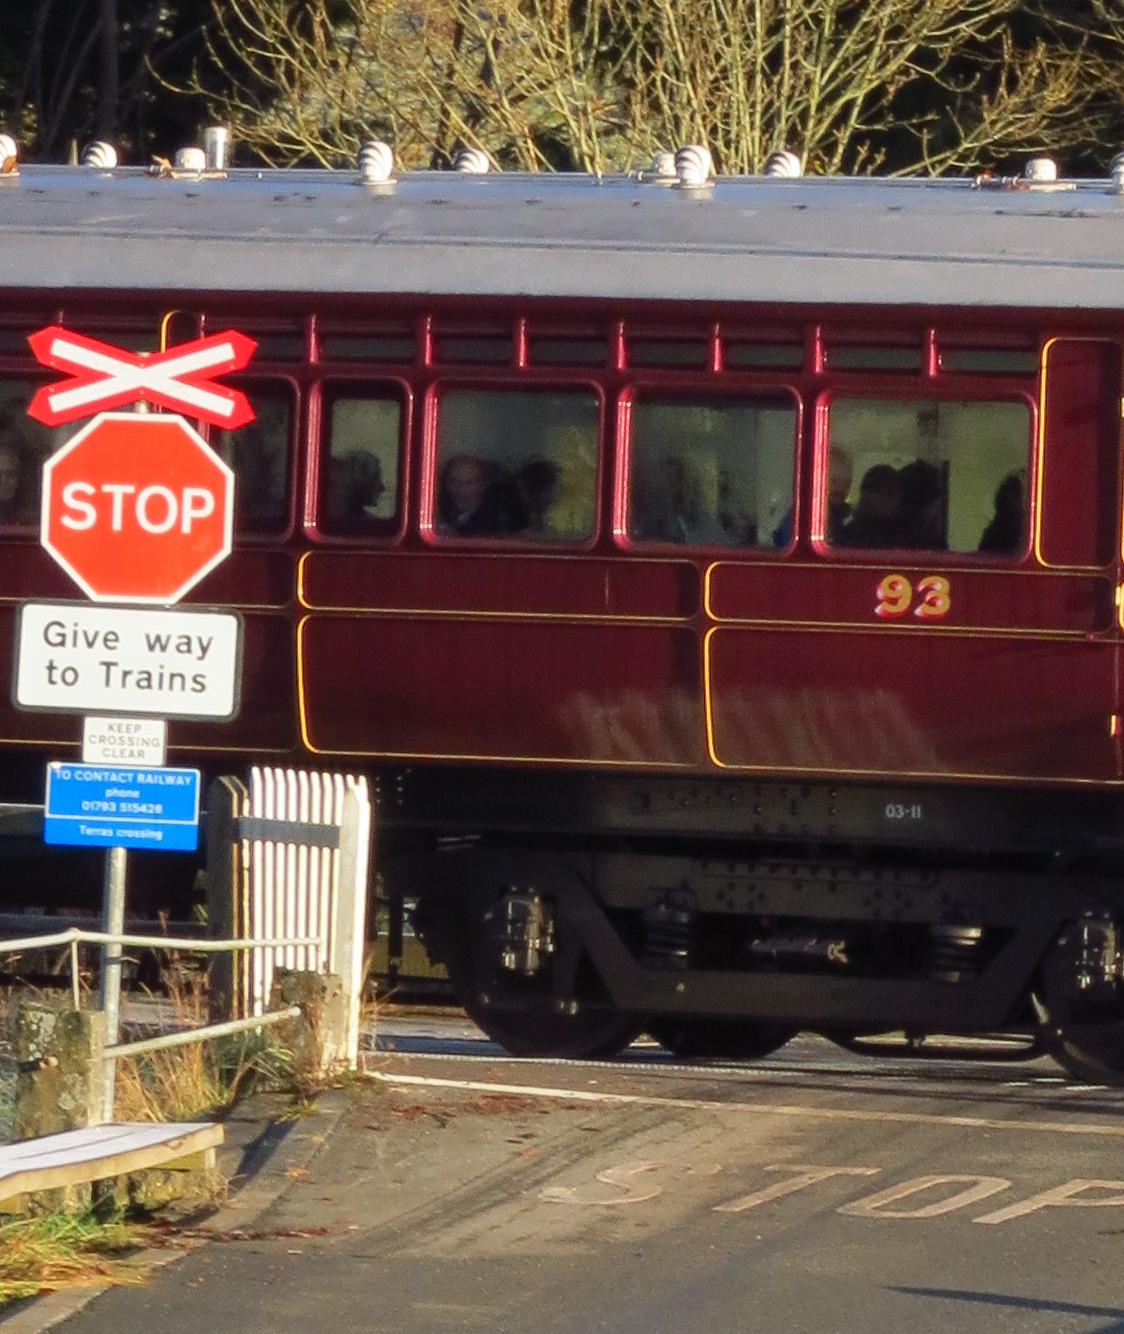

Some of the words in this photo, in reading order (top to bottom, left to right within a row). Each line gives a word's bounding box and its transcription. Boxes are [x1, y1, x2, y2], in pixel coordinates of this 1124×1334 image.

[60, 481, 215, 535] STOP
[874, 574, 951, 617] 93
[43, 620, 120, 650] Give
[144, 632, 214, 661] way
[46, 659, 80, 687] to
[99, 661, 207, 693] Trains
[107, 723, 142, 734] KEEP
[88, 734, 160, 748] CROSSING
[101, 747, 146, 759] CLEAR
[55, 769, 71, 781] TO
[74, 770, 134, 783] CONTACT
[137, 773, 192, 786] RAILWAY
[105, 787, 140, 798] phone
[115, 826, 163, 841] crossing
